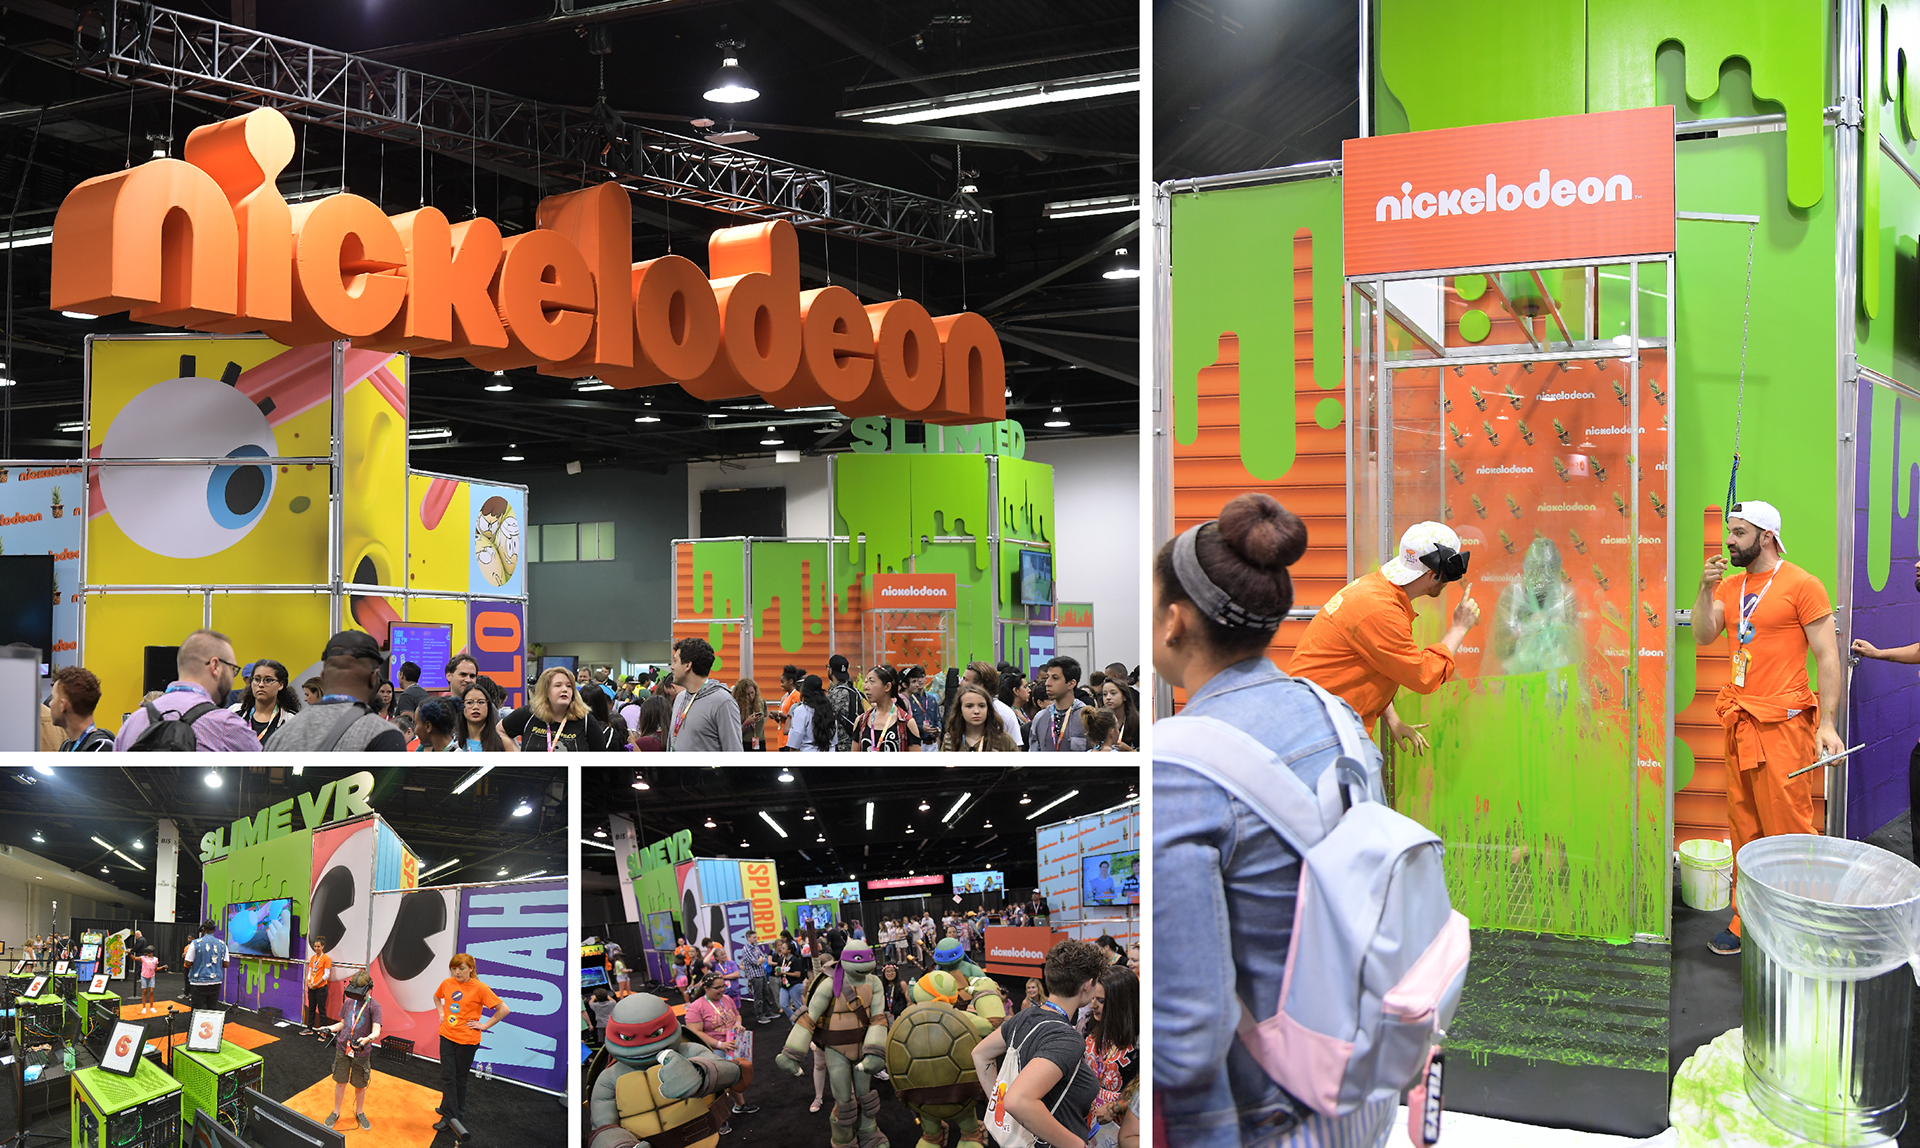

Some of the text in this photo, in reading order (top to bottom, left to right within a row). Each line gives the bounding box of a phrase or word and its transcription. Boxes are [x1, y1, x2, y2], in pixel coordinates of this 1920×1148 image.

[1376, 168, 1633, 222] nickelodeon
[51, 106, 1006, 426] nickelodeon
[850, 415, 1026, 460] SLIMED
[1585, 426, 1645, 436] nickeloden
[1476, 465, 1534, 475] nickelodeon
[1537, 502, 1596, 512] nickelodeon
[881, 585, 947, 596] nickelodeon
[199, 770, 375, 862] SLIME VR
[664, 828, 694, 864] VR
[747, 864, 778, 943] SPLORP!
[990, 946, 1044, 959] nickelodeon
[94, 979, 104, 988] 2
[464, 889, 568, 1070] WOAH
[198, 1021, 214, 1040] 3
[114, 1034, 133, 1058] 6
